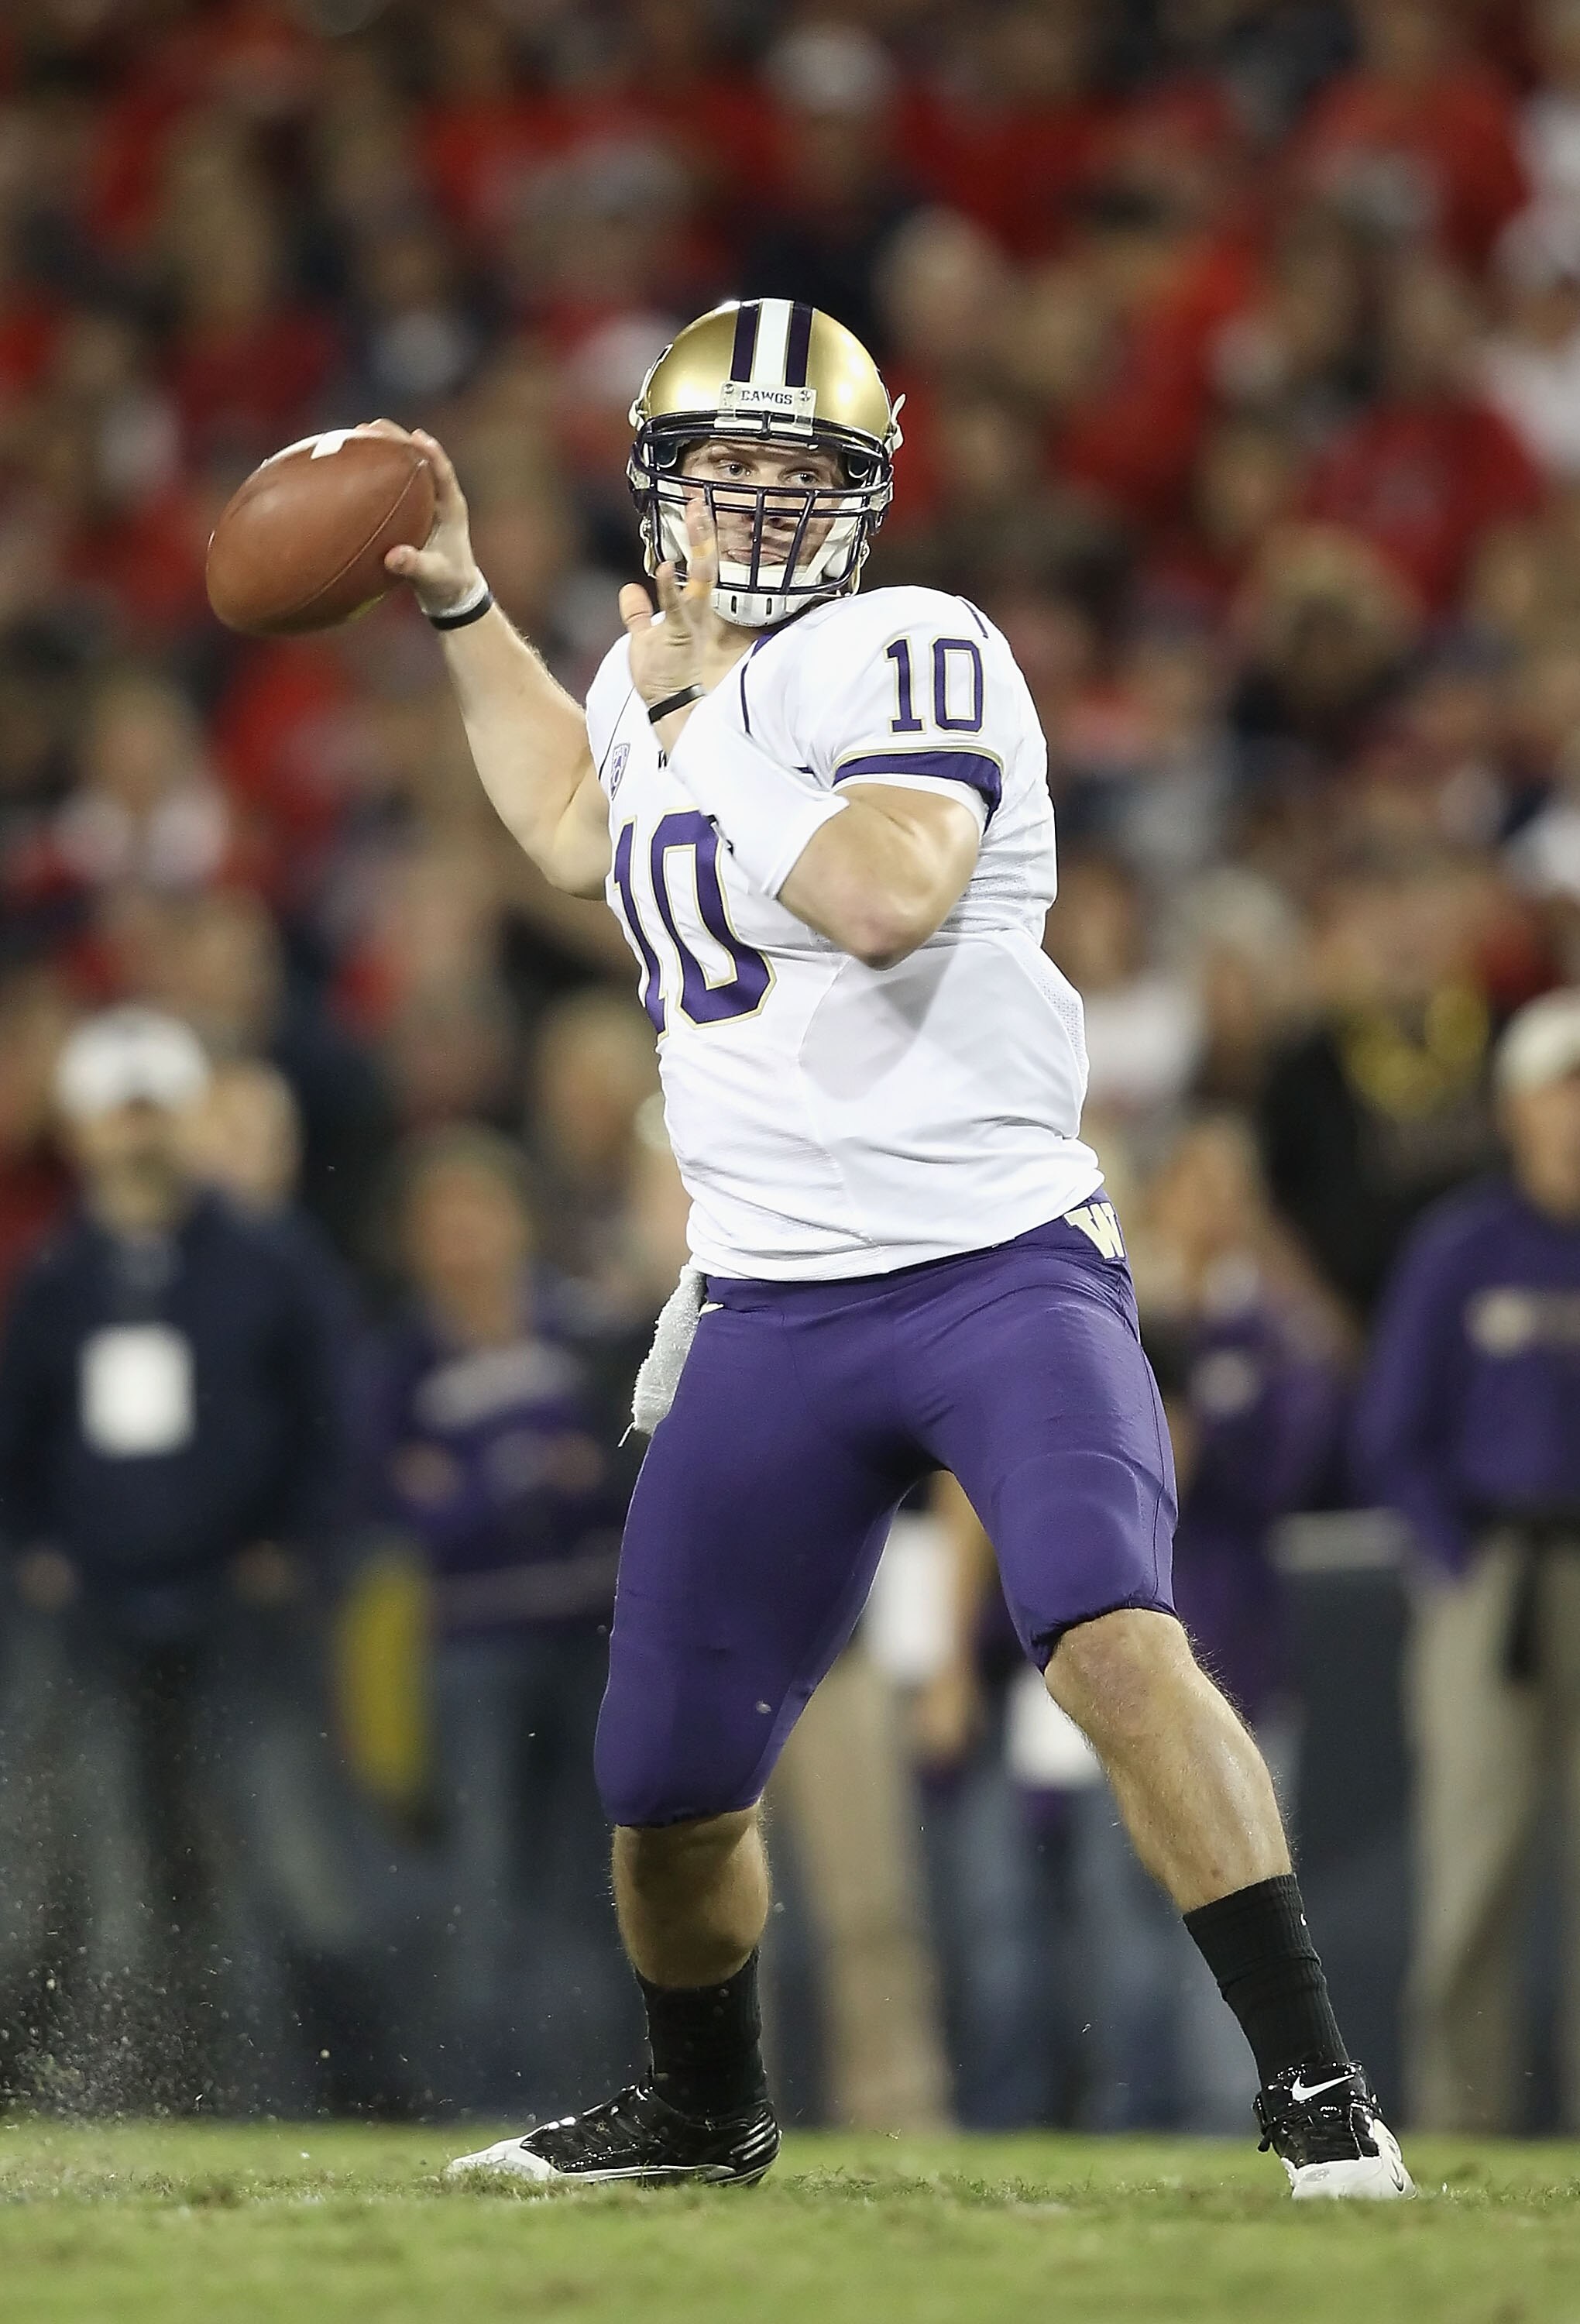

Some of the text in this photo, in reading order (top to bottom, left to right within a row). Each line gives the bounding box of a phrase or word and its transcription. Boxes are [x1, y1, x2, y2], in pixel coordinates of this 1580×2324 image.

[740, 390, 793, 405] DAWGS
[884, 636, 986, 736] 10
[613, 806, 778, 1041] 10
[1063, 1202, 1126, 1260] W
